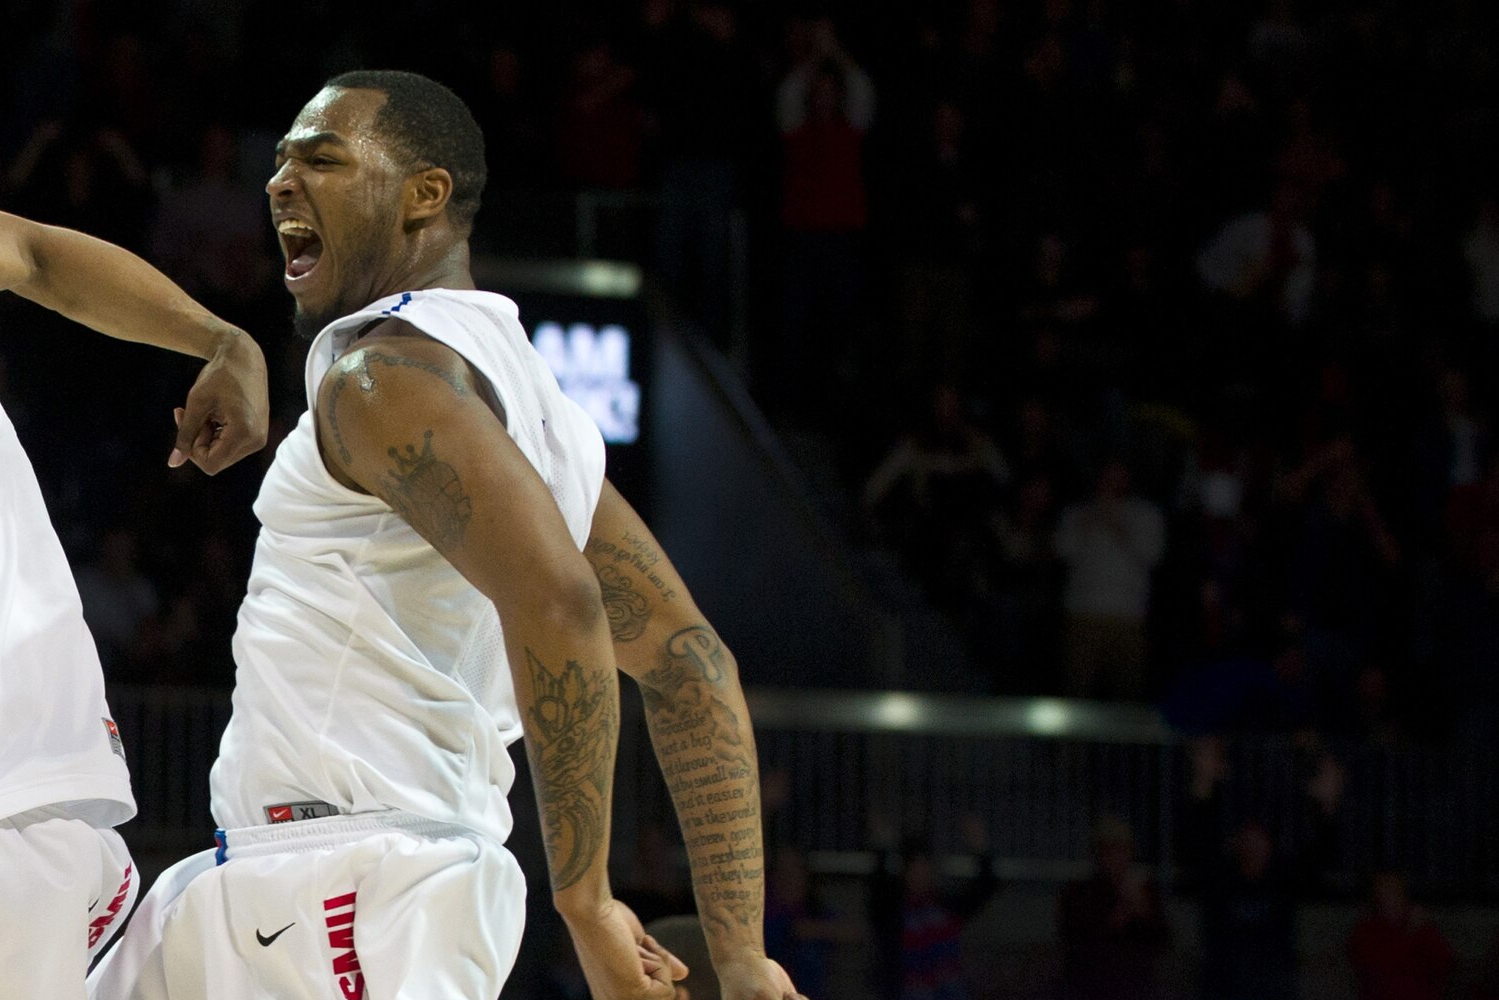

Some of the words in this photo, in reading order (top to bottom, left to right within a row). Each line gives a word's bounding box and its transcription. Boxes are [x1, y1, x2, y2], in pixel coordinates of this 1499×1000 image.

[690, 732, 712, 751] big
[694, 765, 727, 788] small
[706, 788, 744, 804] easier
[299, 807, 321, 820] XL
